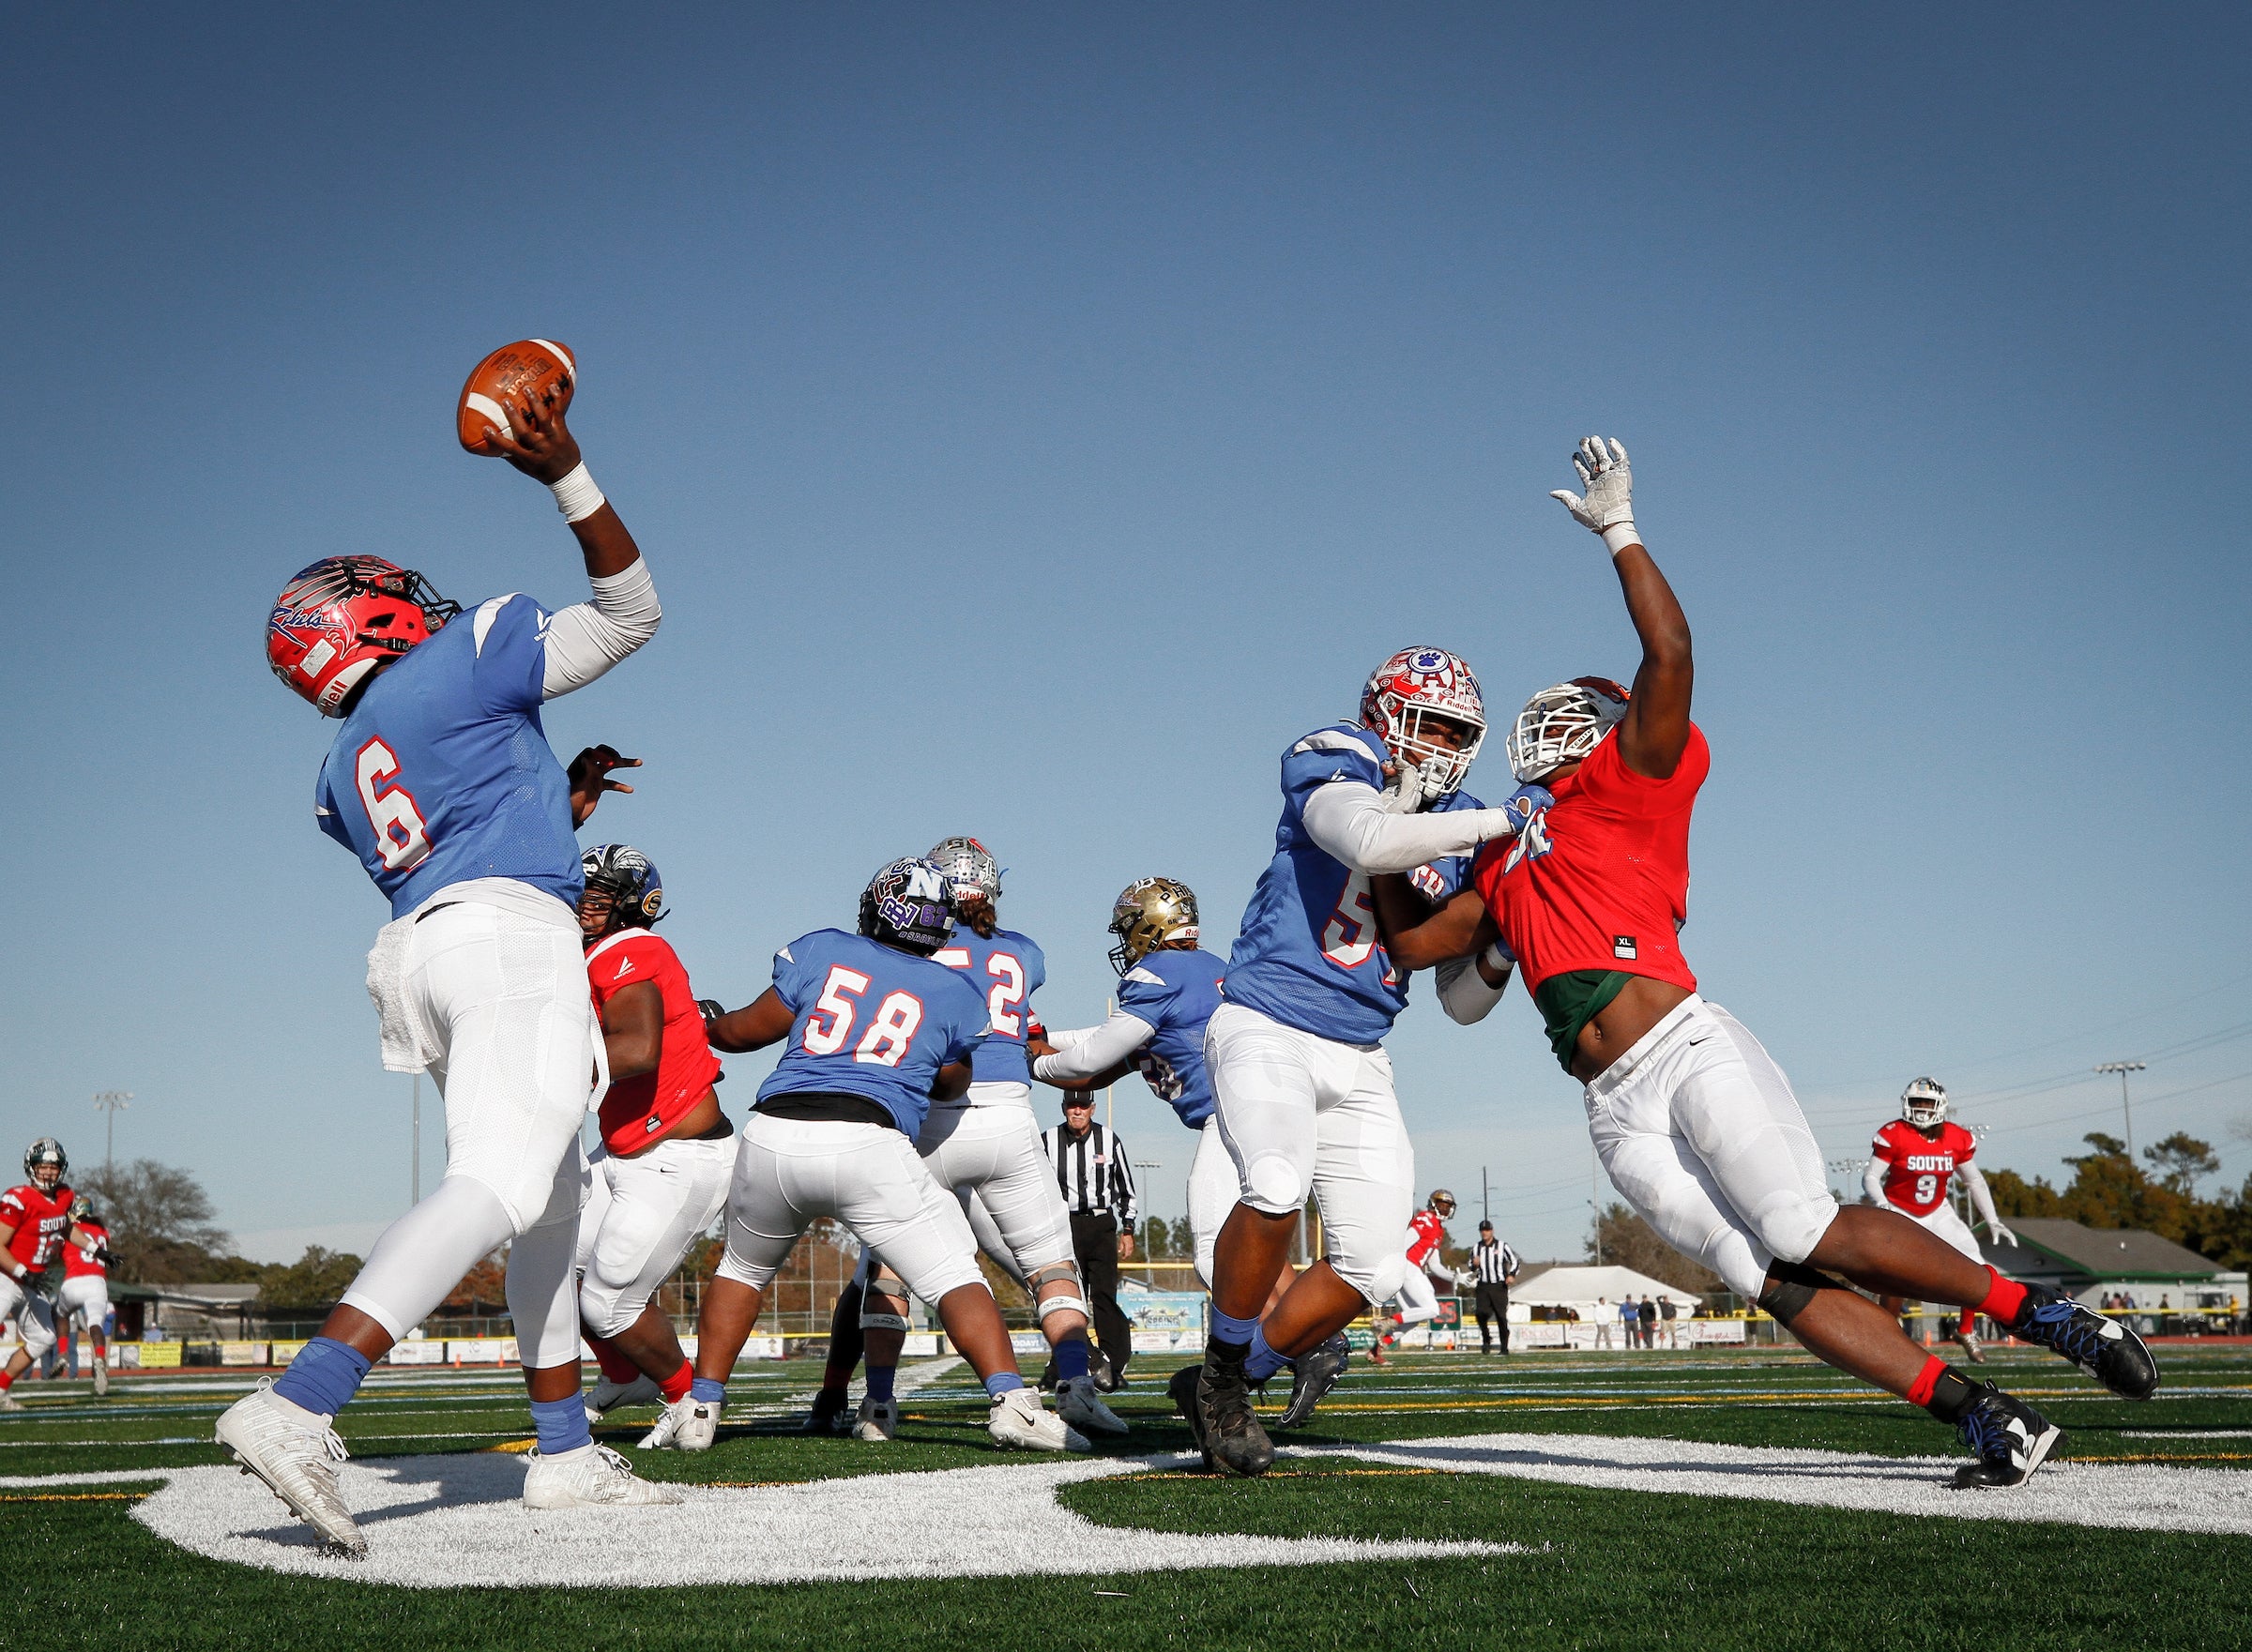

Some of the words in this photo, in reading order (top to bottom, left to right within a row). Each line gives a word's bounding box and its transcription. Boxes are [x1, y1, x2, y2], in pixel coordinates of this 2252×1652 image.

[1447, 699, 1472, 713] Riddell
[1569, 727, 1593, 750] XENITH
[355, 735, 434, 873] 6
[956, 890, 988, 900] ddell
[1619, 937, 1631, 946] XL
[802, 963, 924, 1068] 58
[1907, 1156, 1954, 1171] SOUTH
[1915, 1175, 1937, 1205] 9
